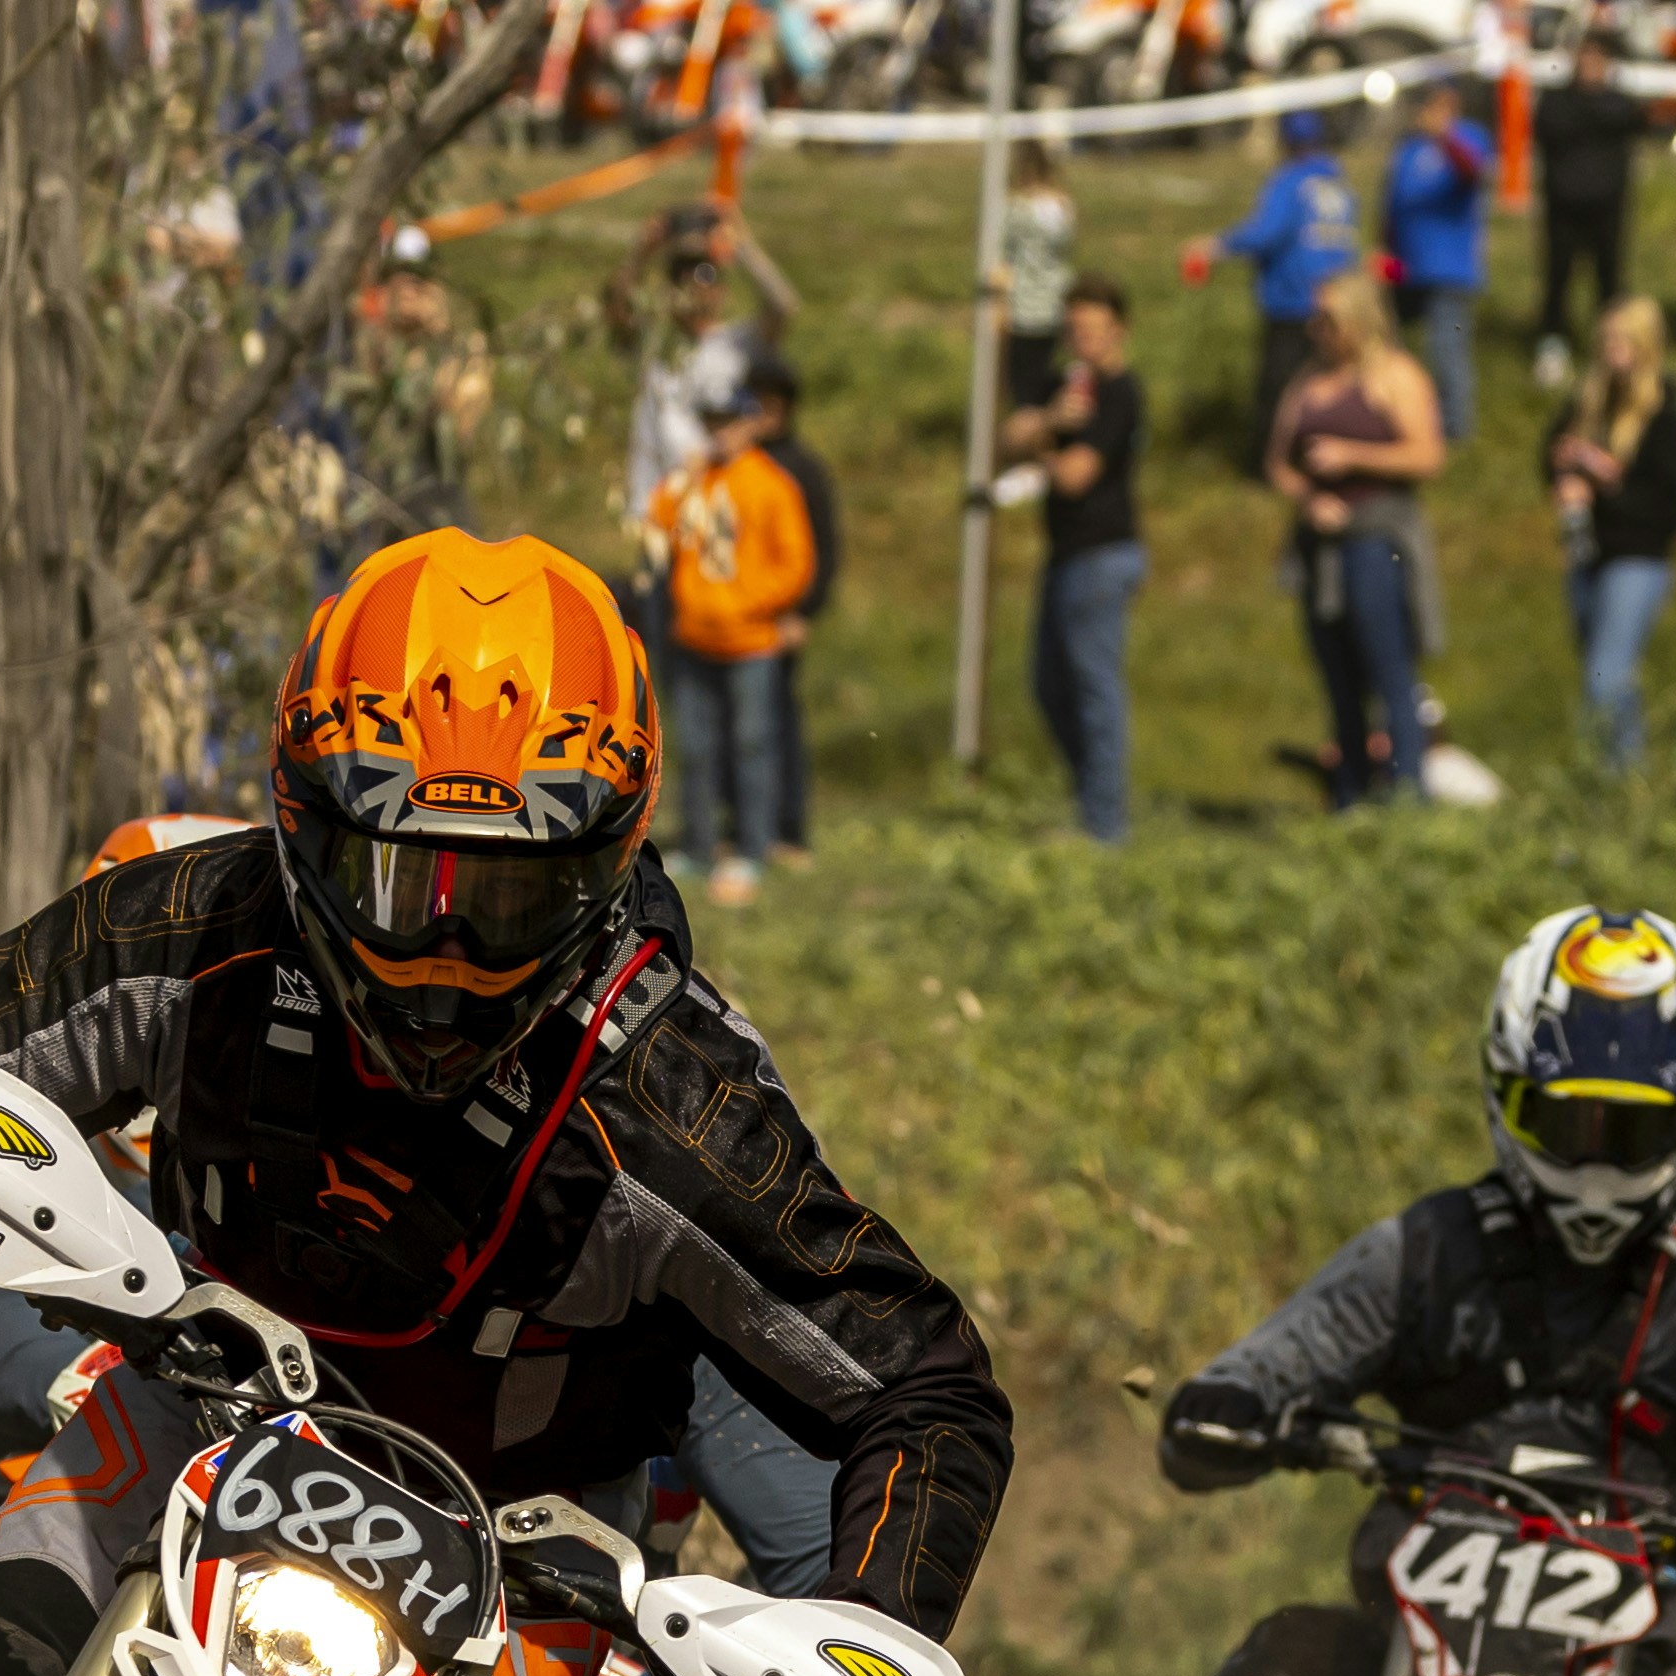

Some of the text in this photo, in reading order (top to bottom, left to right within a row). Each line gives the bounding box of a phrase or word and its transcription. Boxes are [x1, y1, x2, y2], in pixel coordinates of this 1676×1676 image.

[425, 783, 509, 808] BELL
[216, 1435, 470, 1636] 688H
[1413, 1531, 1622, 1641] 412
